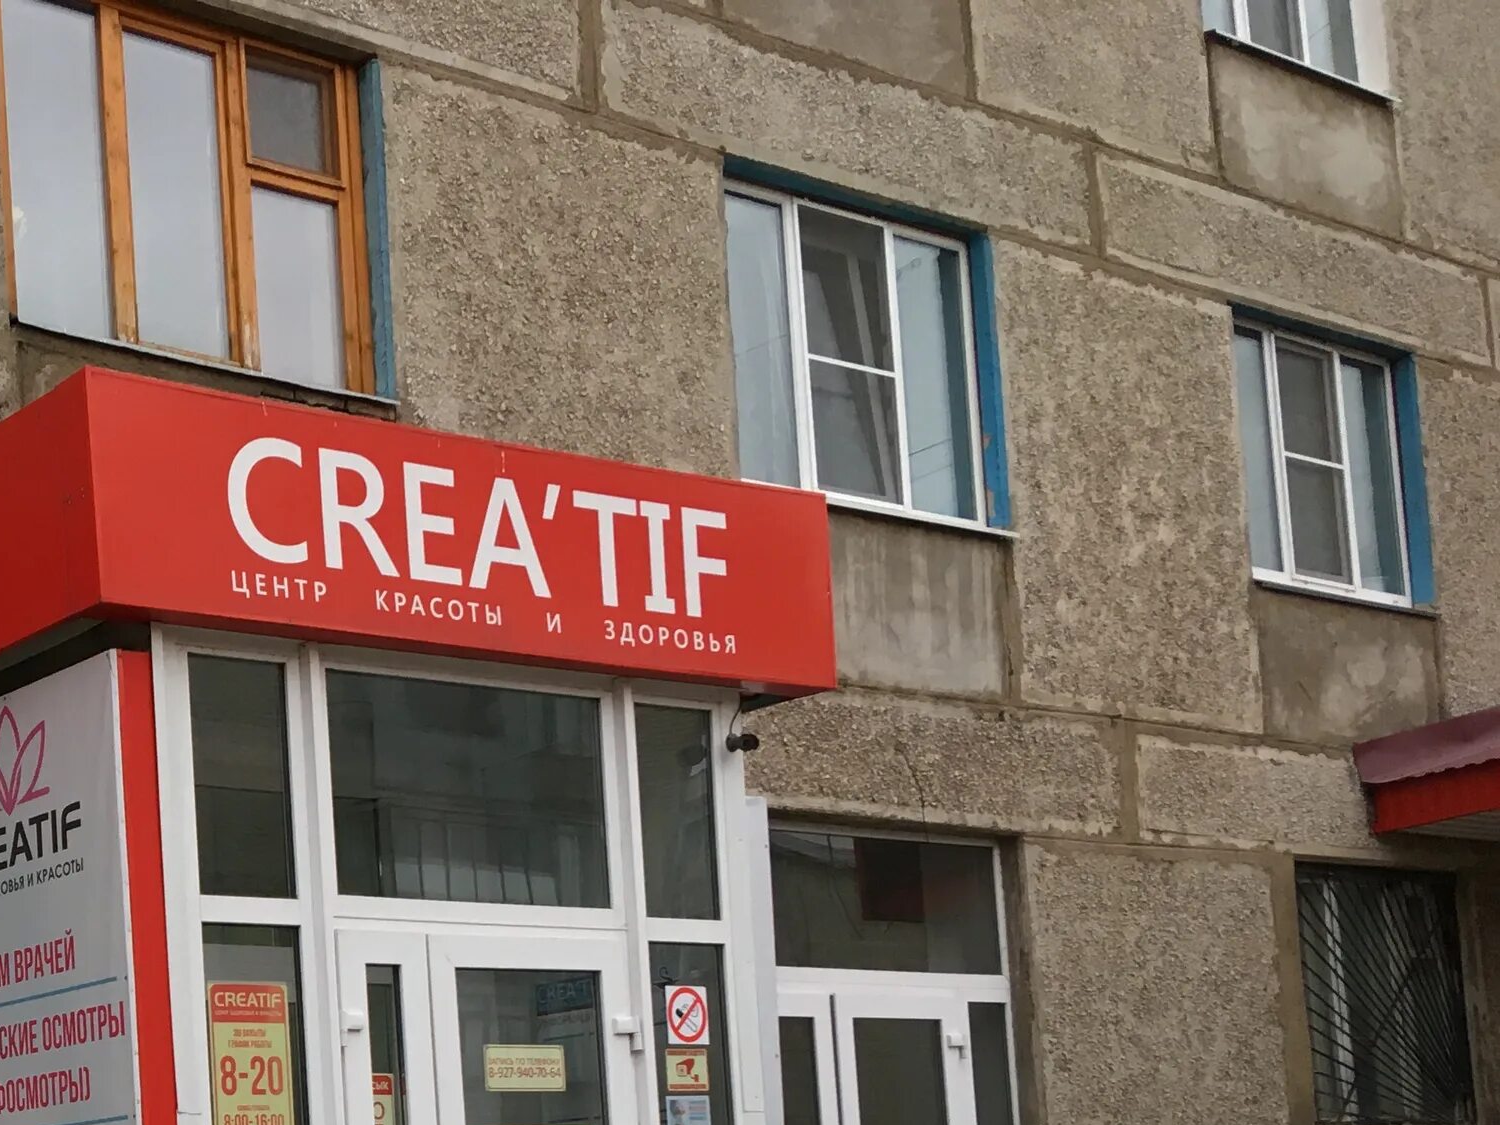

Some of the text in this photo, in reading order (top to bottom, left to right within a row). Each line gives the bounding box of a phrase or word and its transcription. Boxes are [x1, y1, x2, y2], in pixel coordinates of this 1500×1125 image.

[230, 569, 737, 655] ЦЕНТР КРАСОТЫ И ЗДОРОВЬЯ
[27, 873, 34, 887] И
[36, 857, 84, 883] КРАСОТЫ
[14, 928, 76, 983] ВРАЧЕЙ
[214, 991, 282, 1009] CREATIF
[42, 1000, 126, 1051] ОСМОТРЫ
[219, 1054, 284, 1096] 8-20
